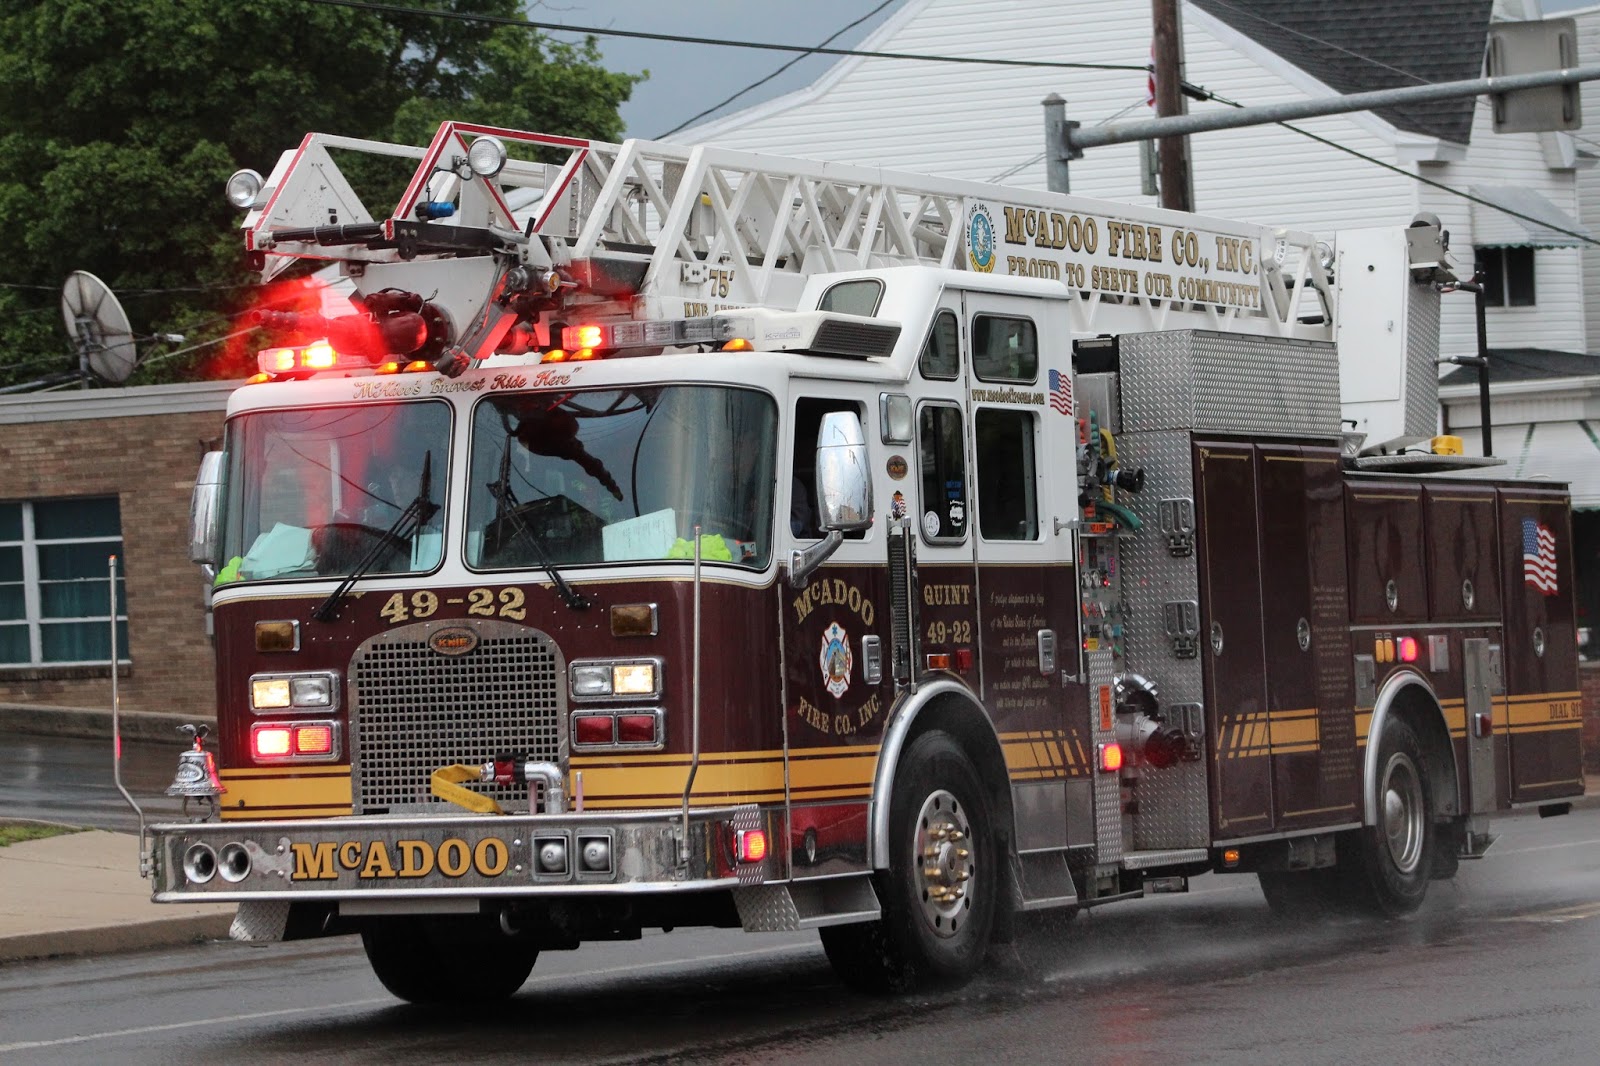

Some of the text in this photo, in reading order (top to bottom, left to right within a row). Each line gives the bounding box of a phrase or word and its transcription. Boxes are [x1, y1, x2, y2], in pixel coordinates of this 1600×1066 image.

[1107, 220, 1163, 263] FIRE
[1172, 230, 1210, 274] CO.,
[1215, 236, 1259, 275] INC.
[1007, 255, 1060, 279] PROUD
[1065, 262, 1085, 288] TO
[1091, 265, 1139, 294] SERVE
[1144, 272, 1173, 298] OUR
[1178, 276, 1260, 308] COMMUNITY
[684, 302, 709, 318] KME
[430, 376, 486, 395] Bravest
[490, 372, 527, 390] Ride
[380, 587, 527, 624] 49-22
[924, 584, 970, 606] QUINT
[927, 620, 971, 644] 49-22
[797, 696, 830, 734] FIRE
[858, 692, 882, 727] INC.
[1549, 702, 1569, 719] DIAL
